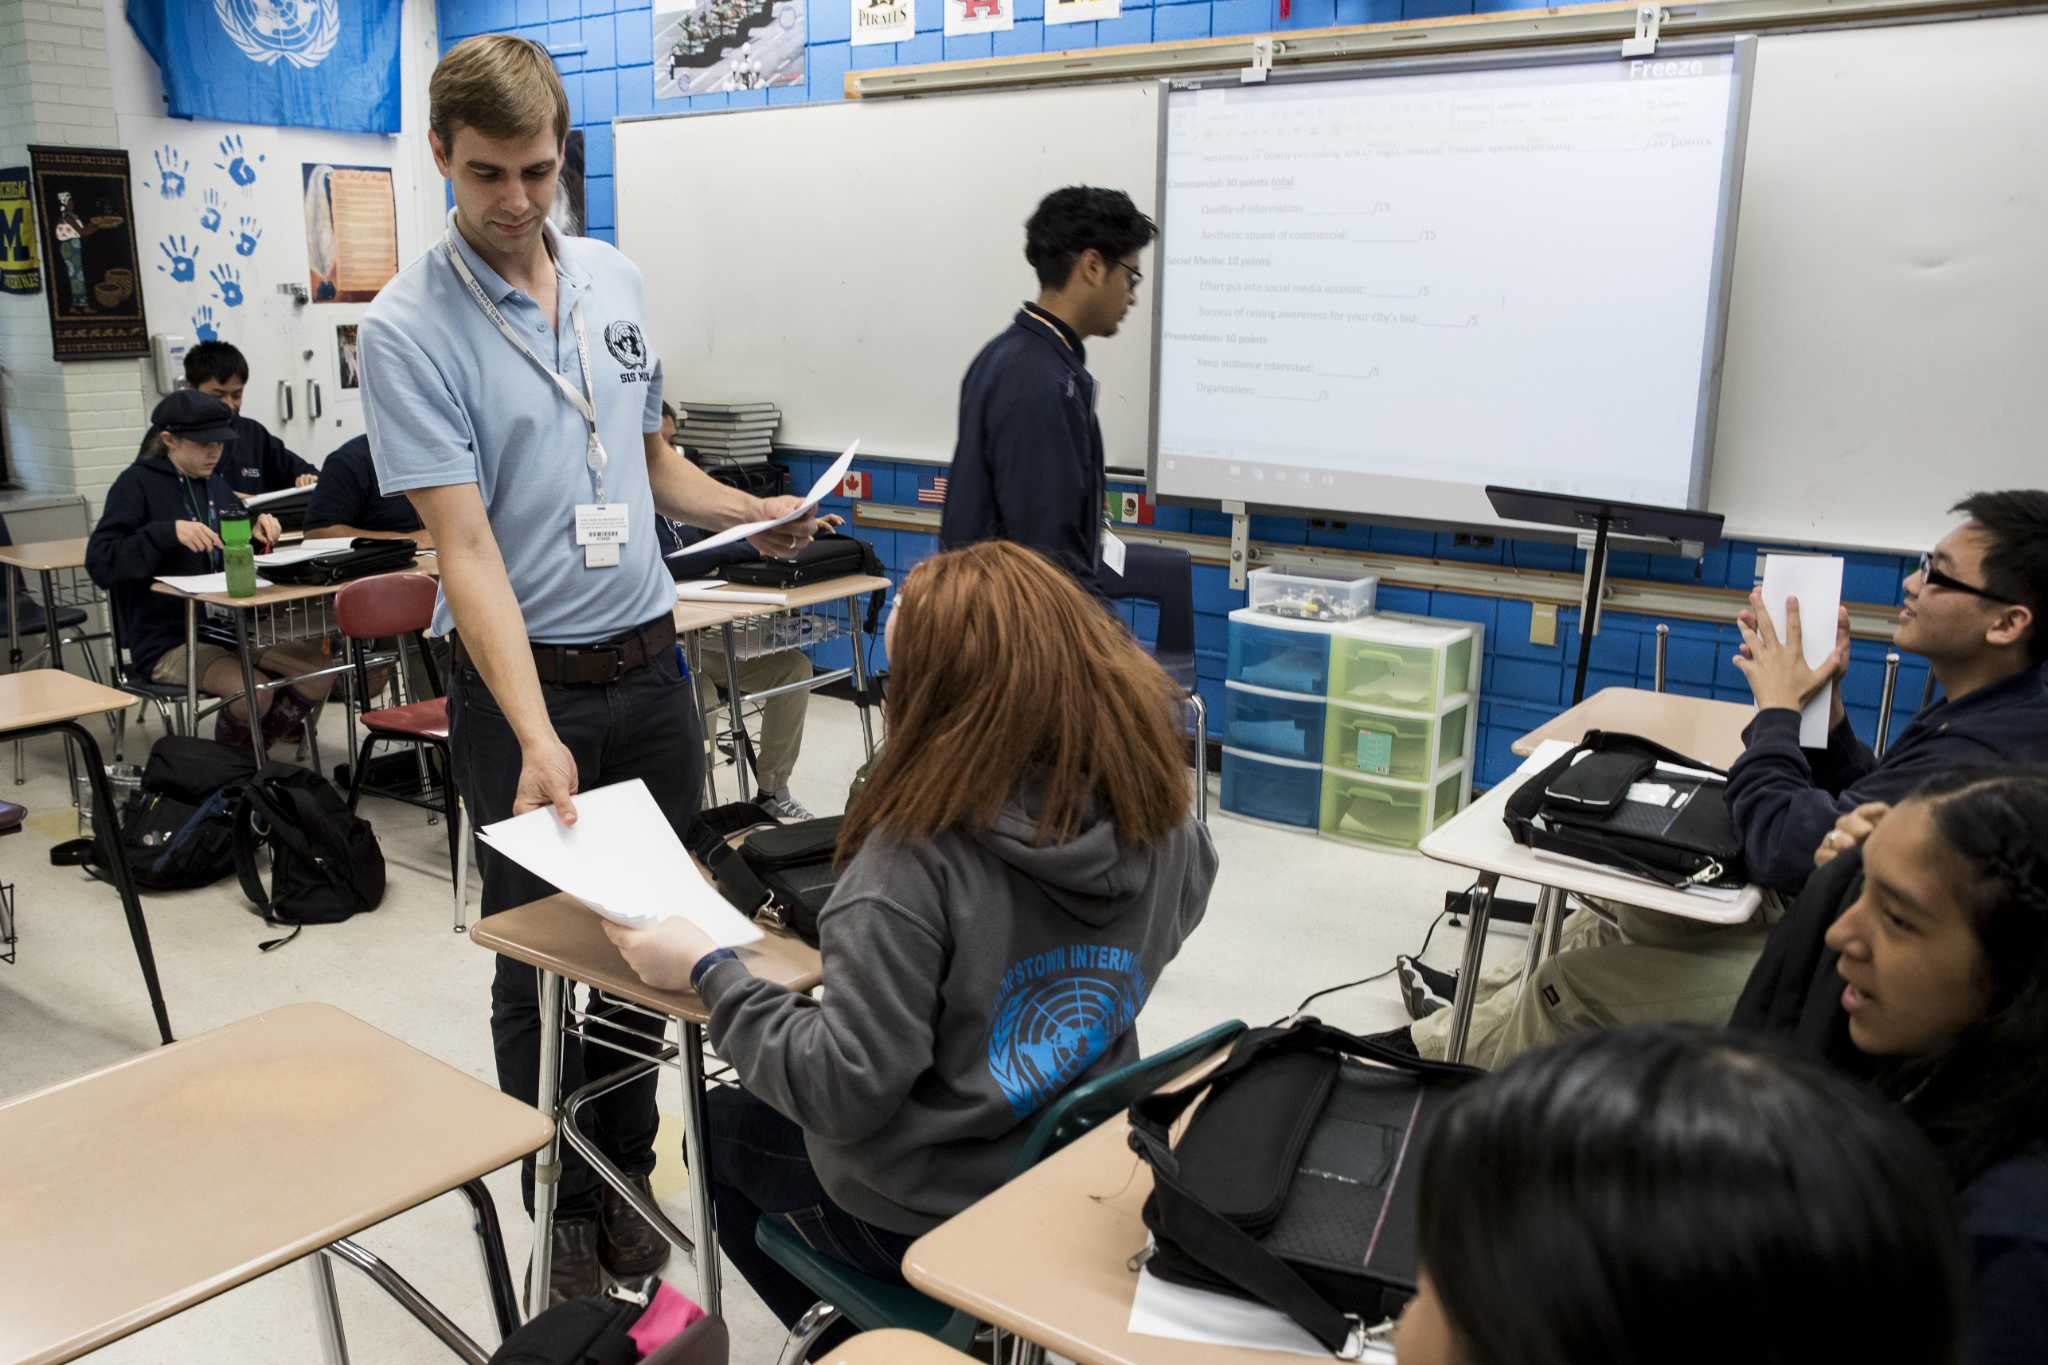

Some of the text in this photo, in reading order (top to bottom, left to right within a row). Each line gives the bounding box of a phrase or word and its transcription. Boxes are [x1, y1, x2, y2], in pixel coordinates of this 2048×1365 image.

[1629, 60, 1704, 79] Freeze
[1330, 309, 1344, 321] for
[1346, 312, 1371, 324] your
[620, 372, 637, 383] SIS
